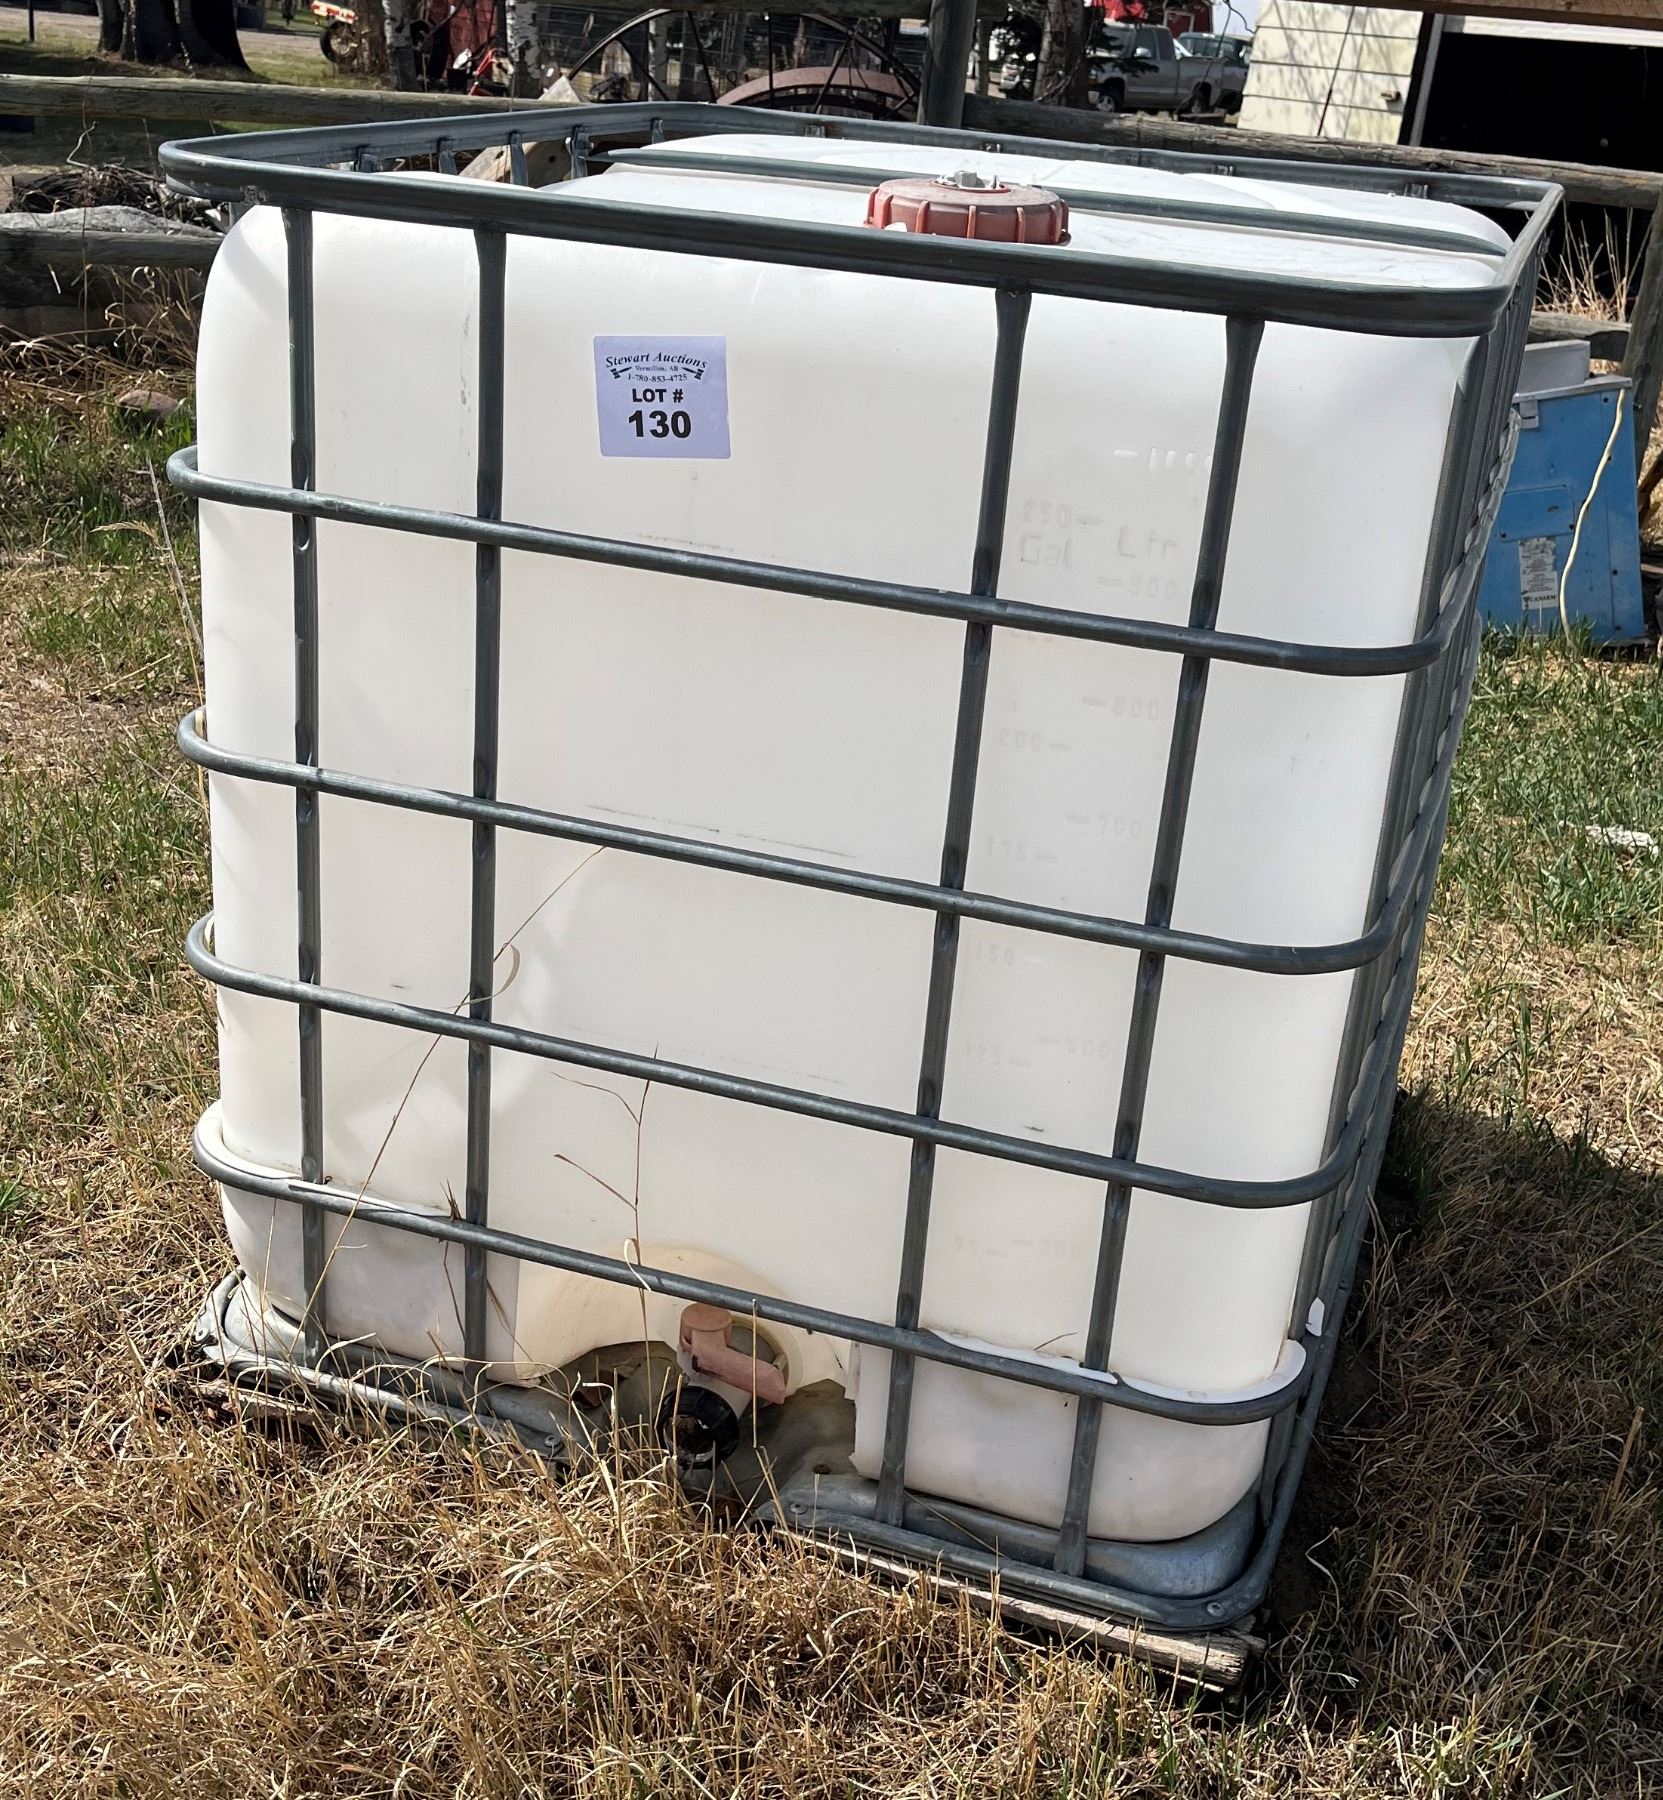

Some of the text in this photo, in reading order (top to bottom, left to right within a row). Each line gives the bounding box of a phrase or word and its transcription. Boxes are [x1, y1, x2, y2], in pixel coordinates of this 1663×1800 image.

[606, 352, 707, 369] Stewart Auctions
[628, 373, 688, 382] 1-780-853-4725
[632, 388, 684, 403] LOT #
[628, 410, 692, 438] 130
[987, 835, 1027, 862] 175
